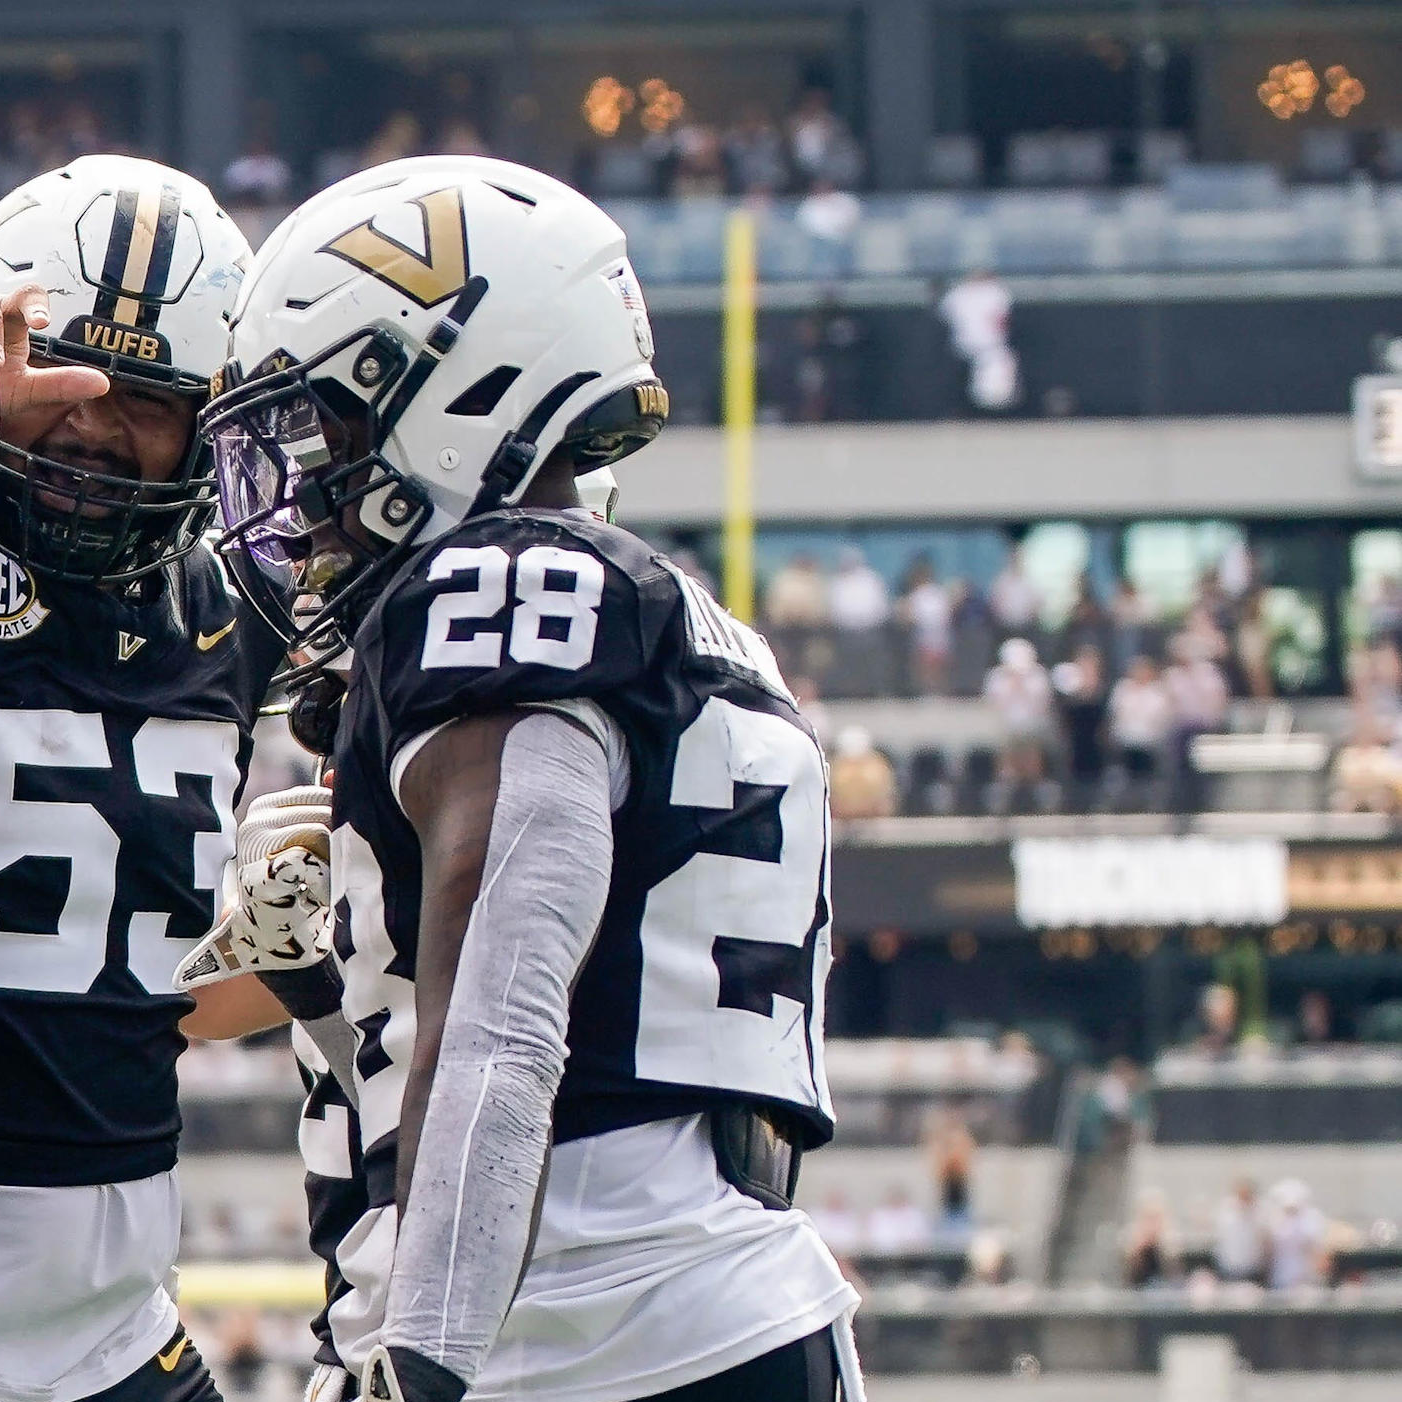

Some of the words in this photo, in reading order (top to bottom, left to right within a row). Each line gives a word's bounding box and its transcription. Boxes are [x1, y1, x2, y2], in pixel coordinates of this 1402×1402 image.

[314, 184, 471, 309] V
[84, 321, 160, 361] VUFB
[117, 630, 147, 661] V
[420, 544, 605, 672] 28
